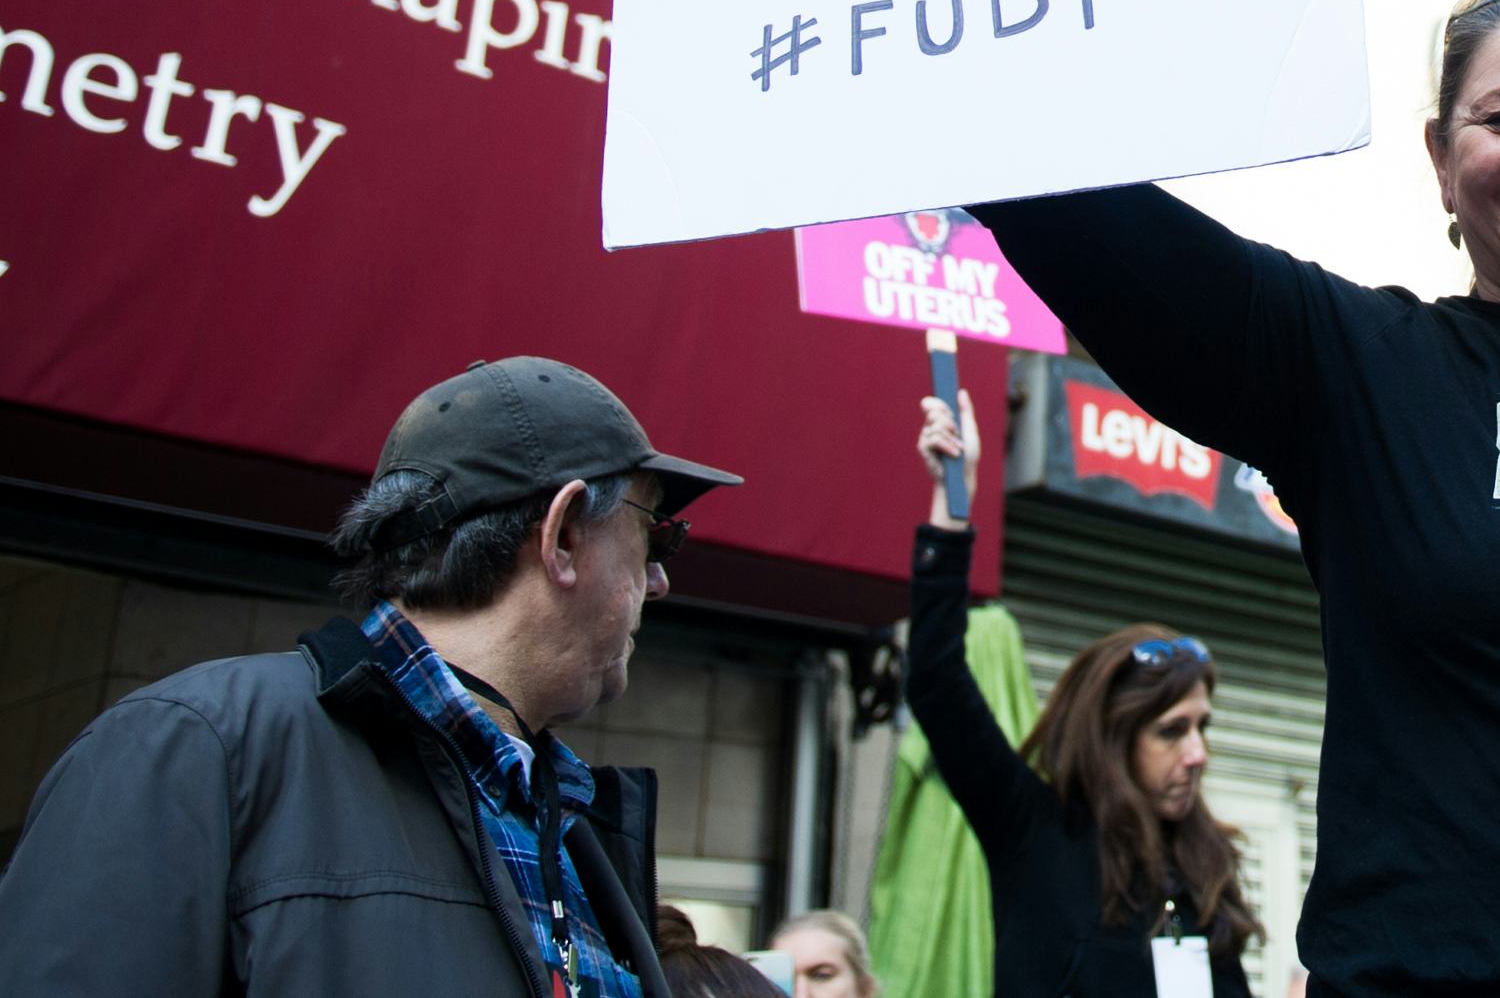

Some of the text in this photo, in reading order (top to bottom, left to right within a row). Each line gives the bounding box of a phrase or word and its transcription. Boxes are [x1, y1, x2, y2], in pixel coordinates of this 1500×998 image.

[864, 240, 998, 298] OFF MY
[863, 276, 1011, 338] UTERUS
